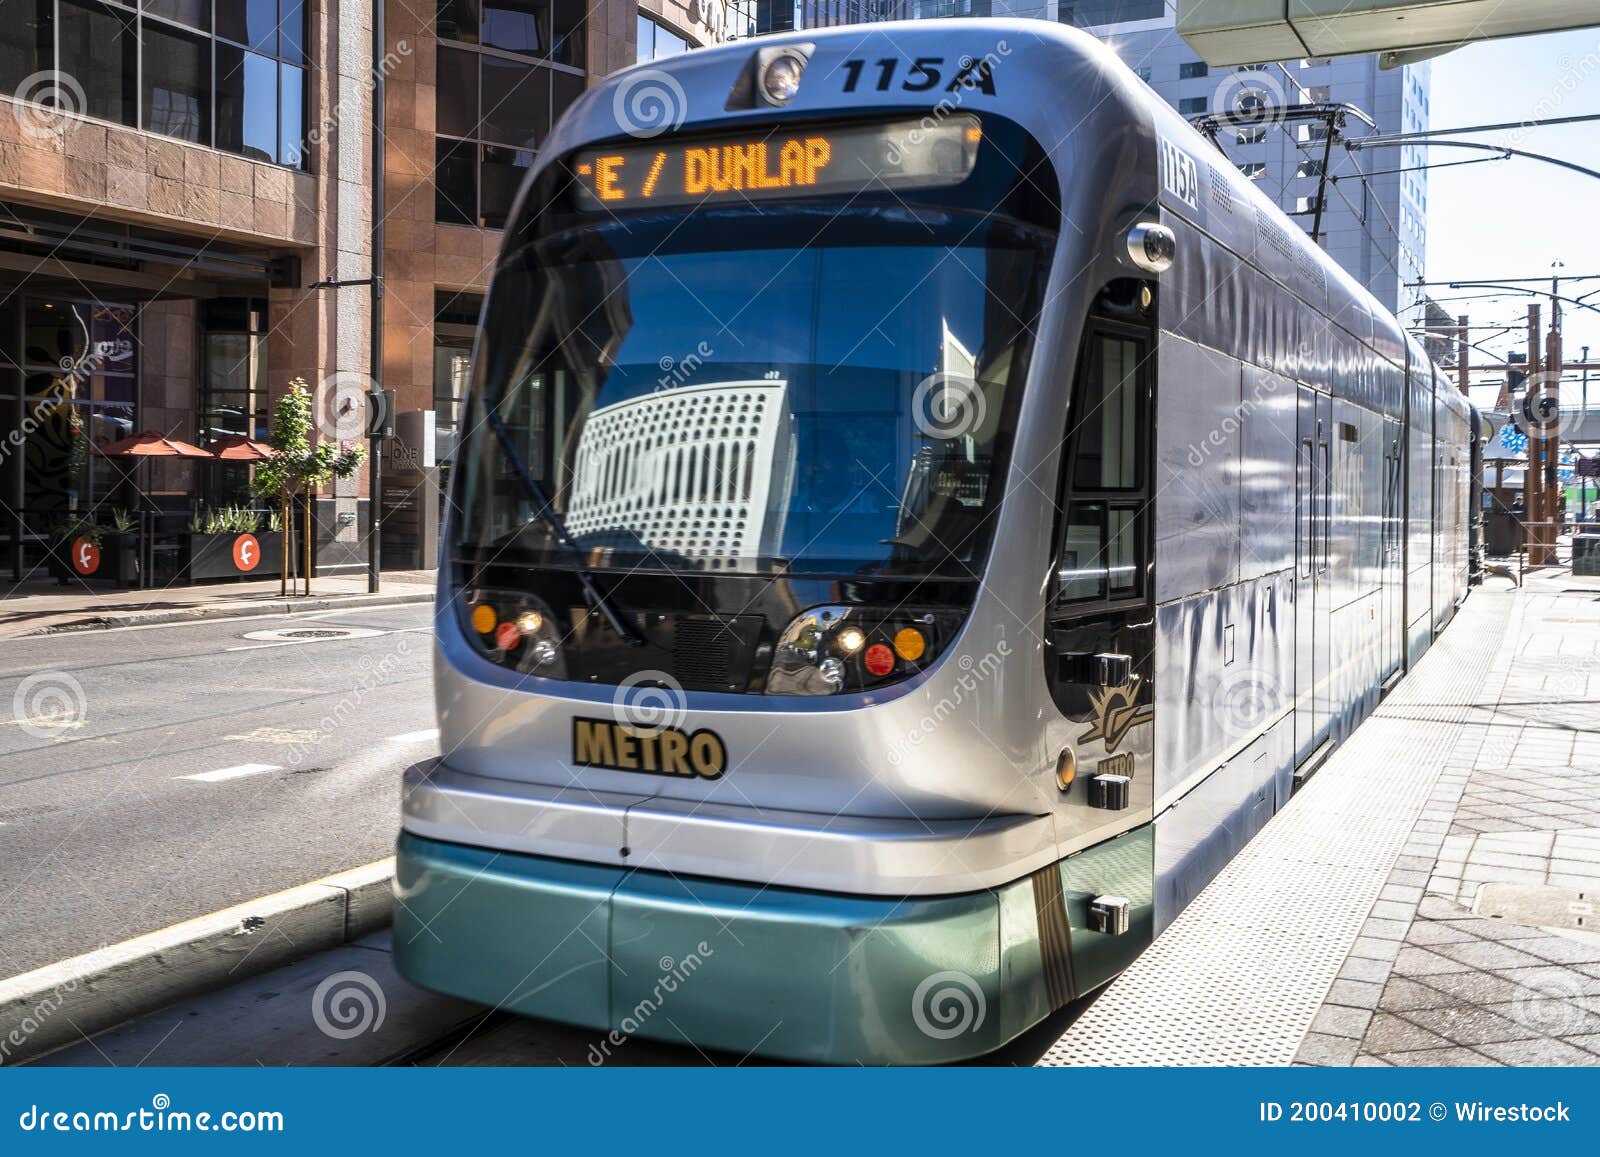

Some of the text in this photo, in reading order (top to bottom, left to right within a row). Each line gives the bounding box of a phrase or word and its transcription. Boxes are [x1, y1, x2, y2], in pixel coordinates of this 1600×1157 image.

[842, 57, 997, 97] 115A
[685, 136, 831, 194] DUNLAP
[1161, 137, 1199, 211] 115A
[393, 447, 418, 460] ONE
[573, 716, 727, 780] METRO
